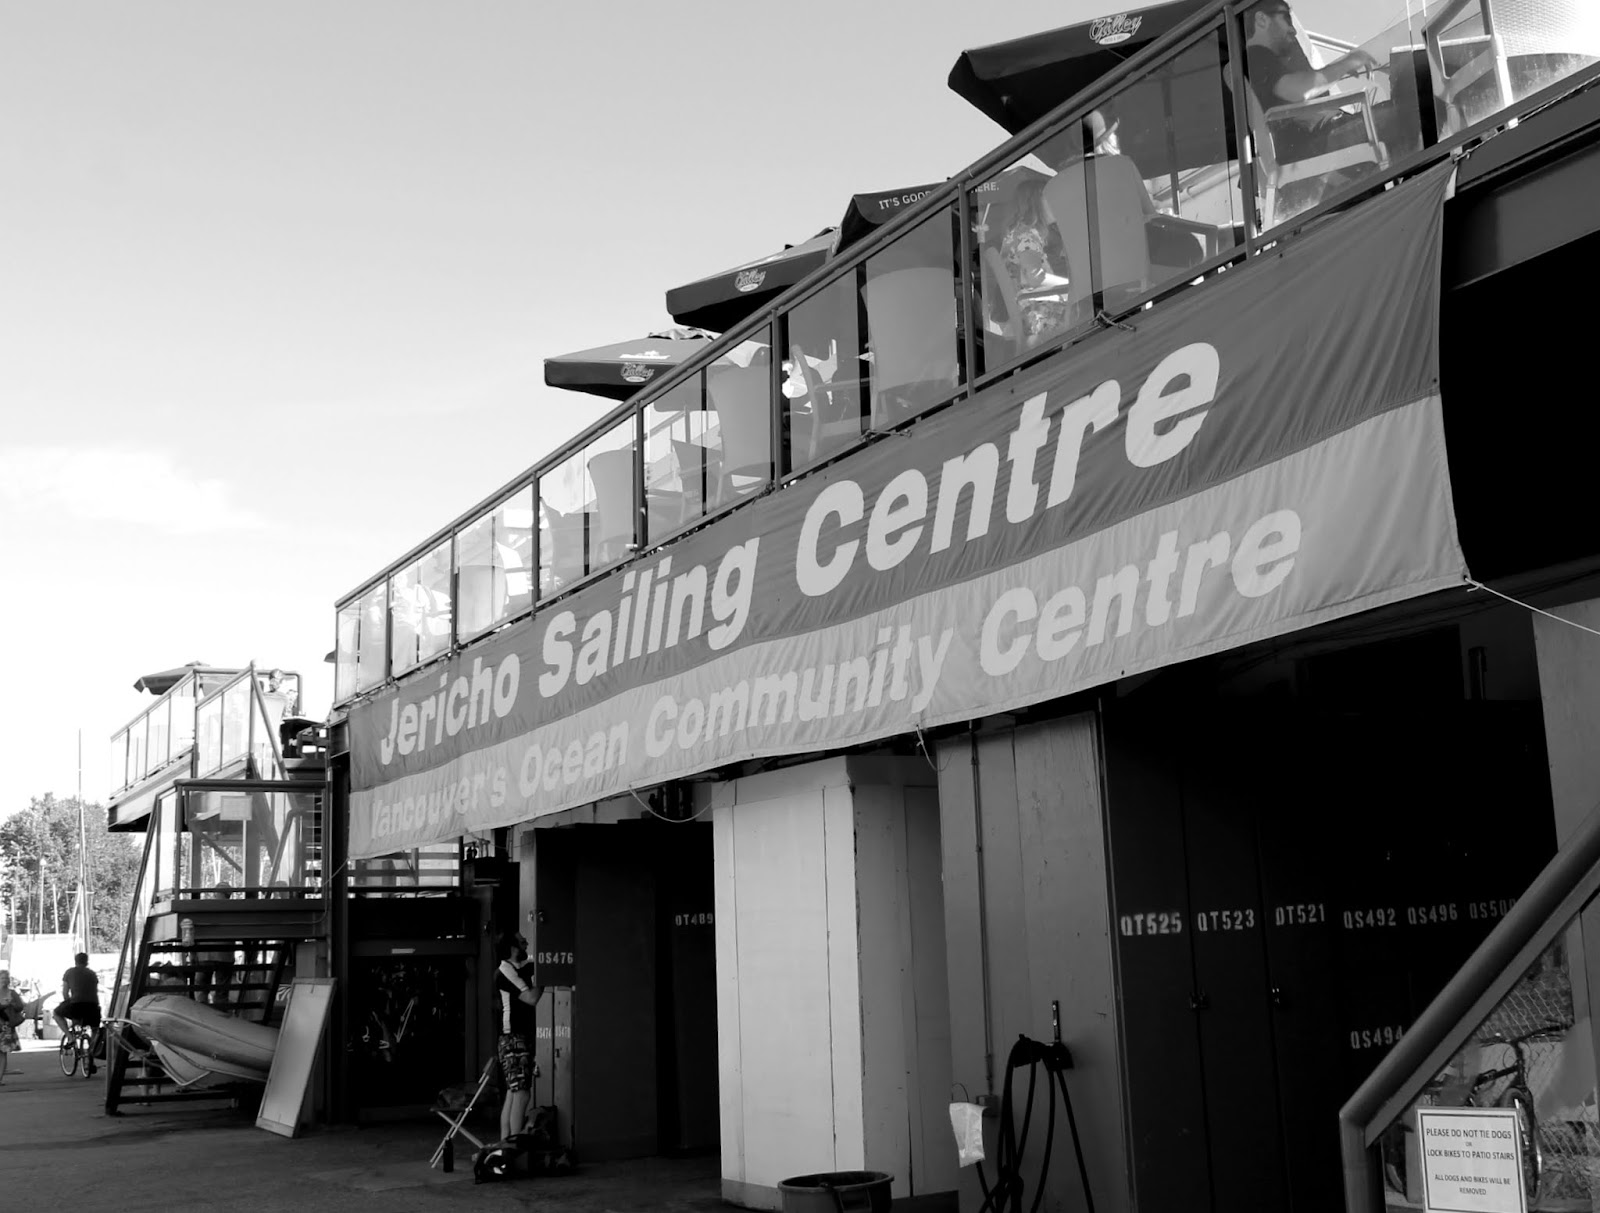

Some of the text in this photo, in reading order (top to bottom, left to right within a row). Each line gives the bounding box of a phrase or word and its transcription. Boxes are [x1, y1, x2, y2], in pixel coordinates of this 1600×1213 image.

[878, 197, 900, 210] IT'S
[971, 182, 999, 193] ERE.
[380, 342, 1220, 765] Jericho Sailing Centre
[371, 510, 1301, 839] Vancouver's Ocean Community Centre
[1426, 1128, 1512, 1139] PLEASE DO NOT TIE DOGS
[1427, 1149, 1515, 1160] LOCK BIKES TO PATIO STAIRS
[1473, 1176, 1488, 1184] BIKES
[1459, 1187, 1487, 1195] REMOVED
